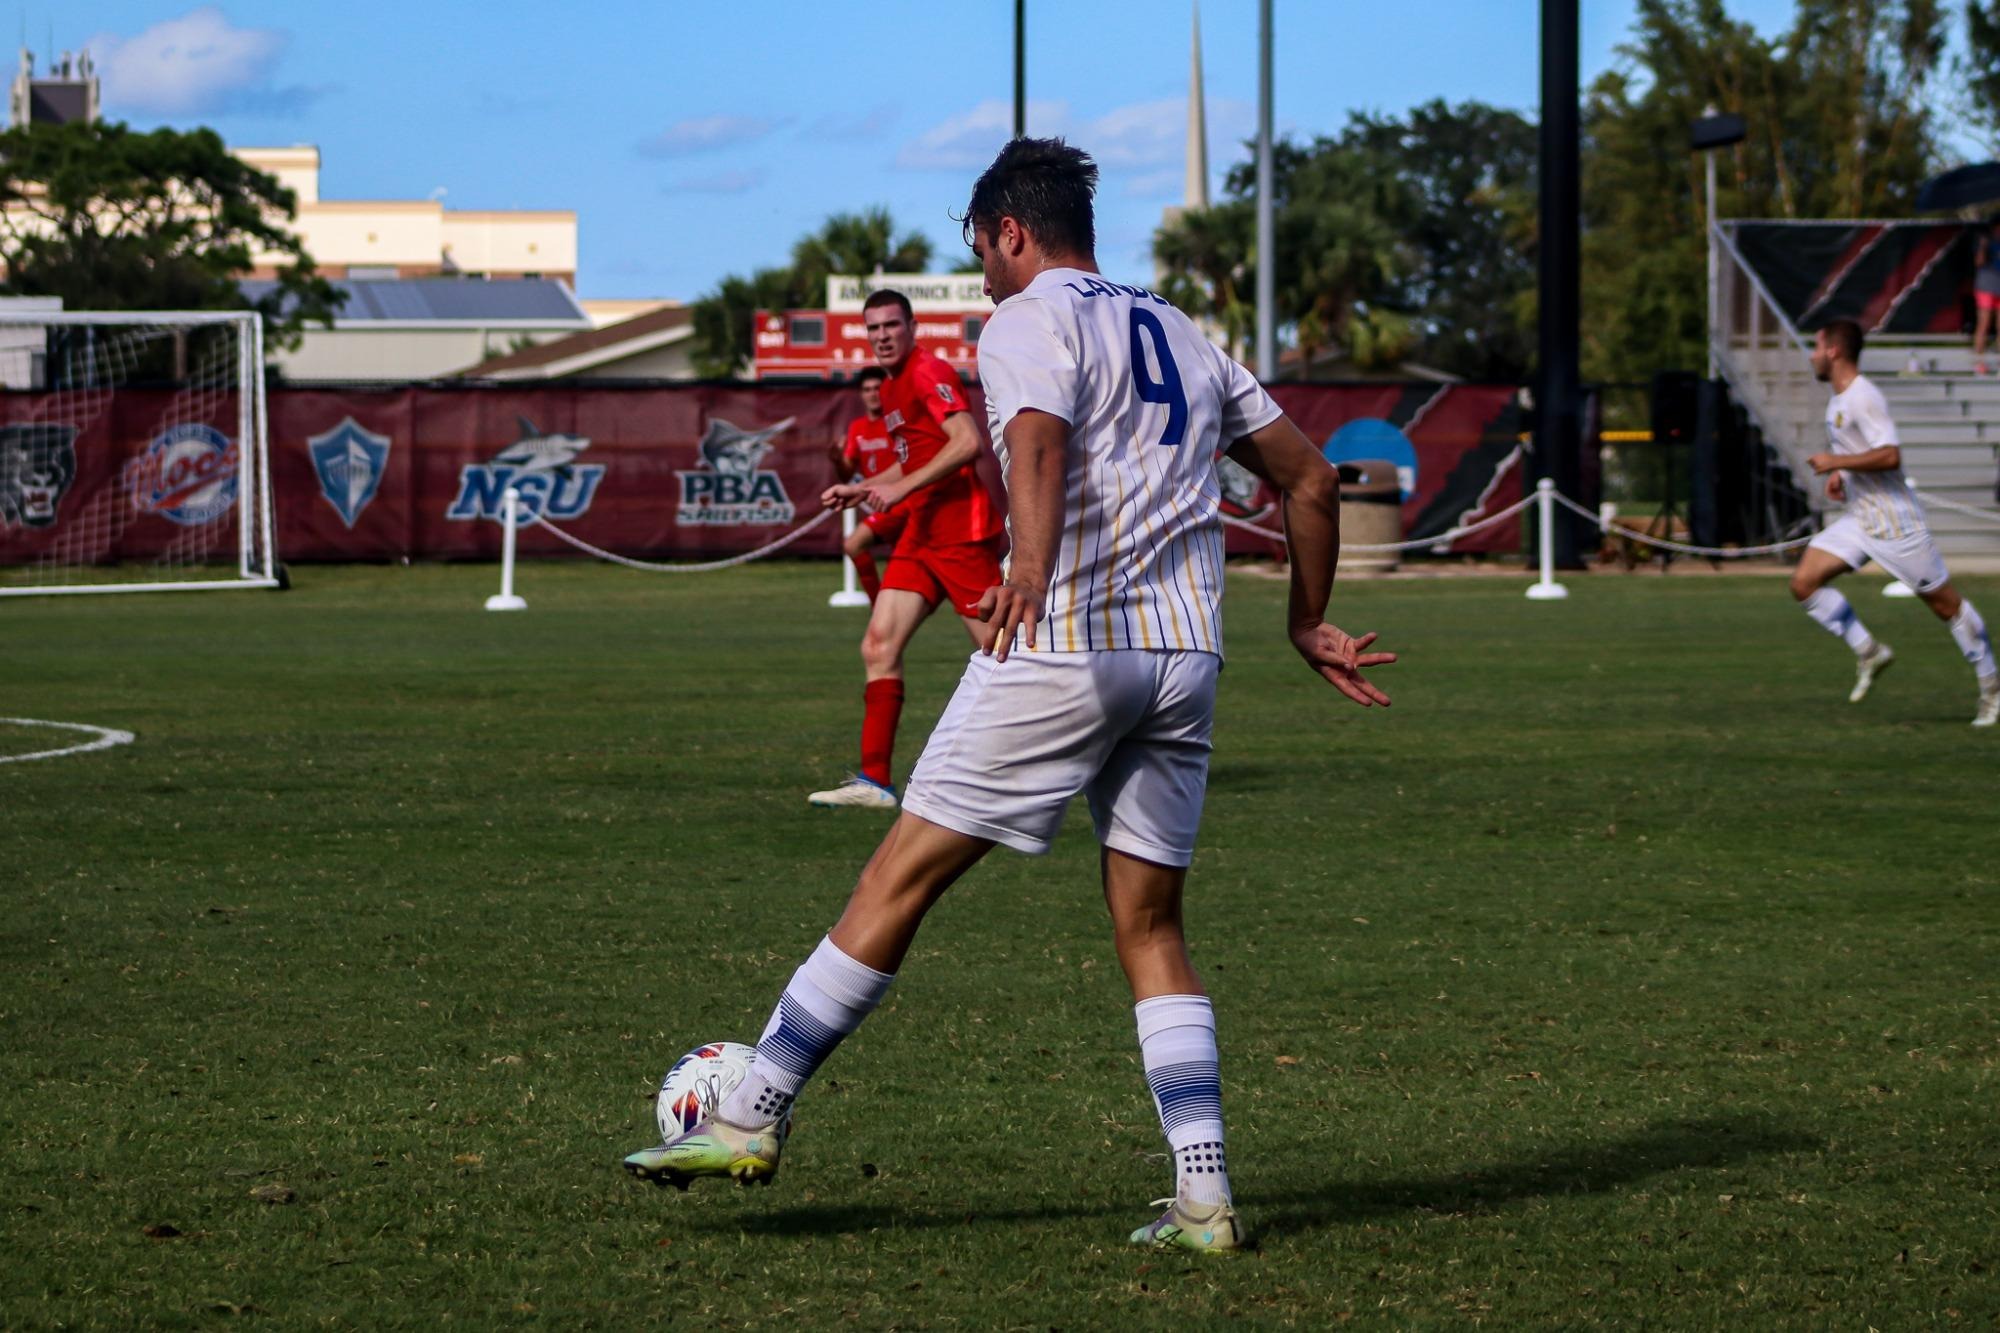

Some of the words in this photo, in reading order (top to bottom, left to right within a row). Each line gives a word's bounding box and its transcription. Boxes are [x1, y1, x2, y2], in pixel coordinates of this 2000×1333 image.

[1061, 277, 1175, 307] LAND
[1129, 306, 1188, 446] 9
[447, 464, 605, 526] NSU
[679, 470, 788, 506] PBA
